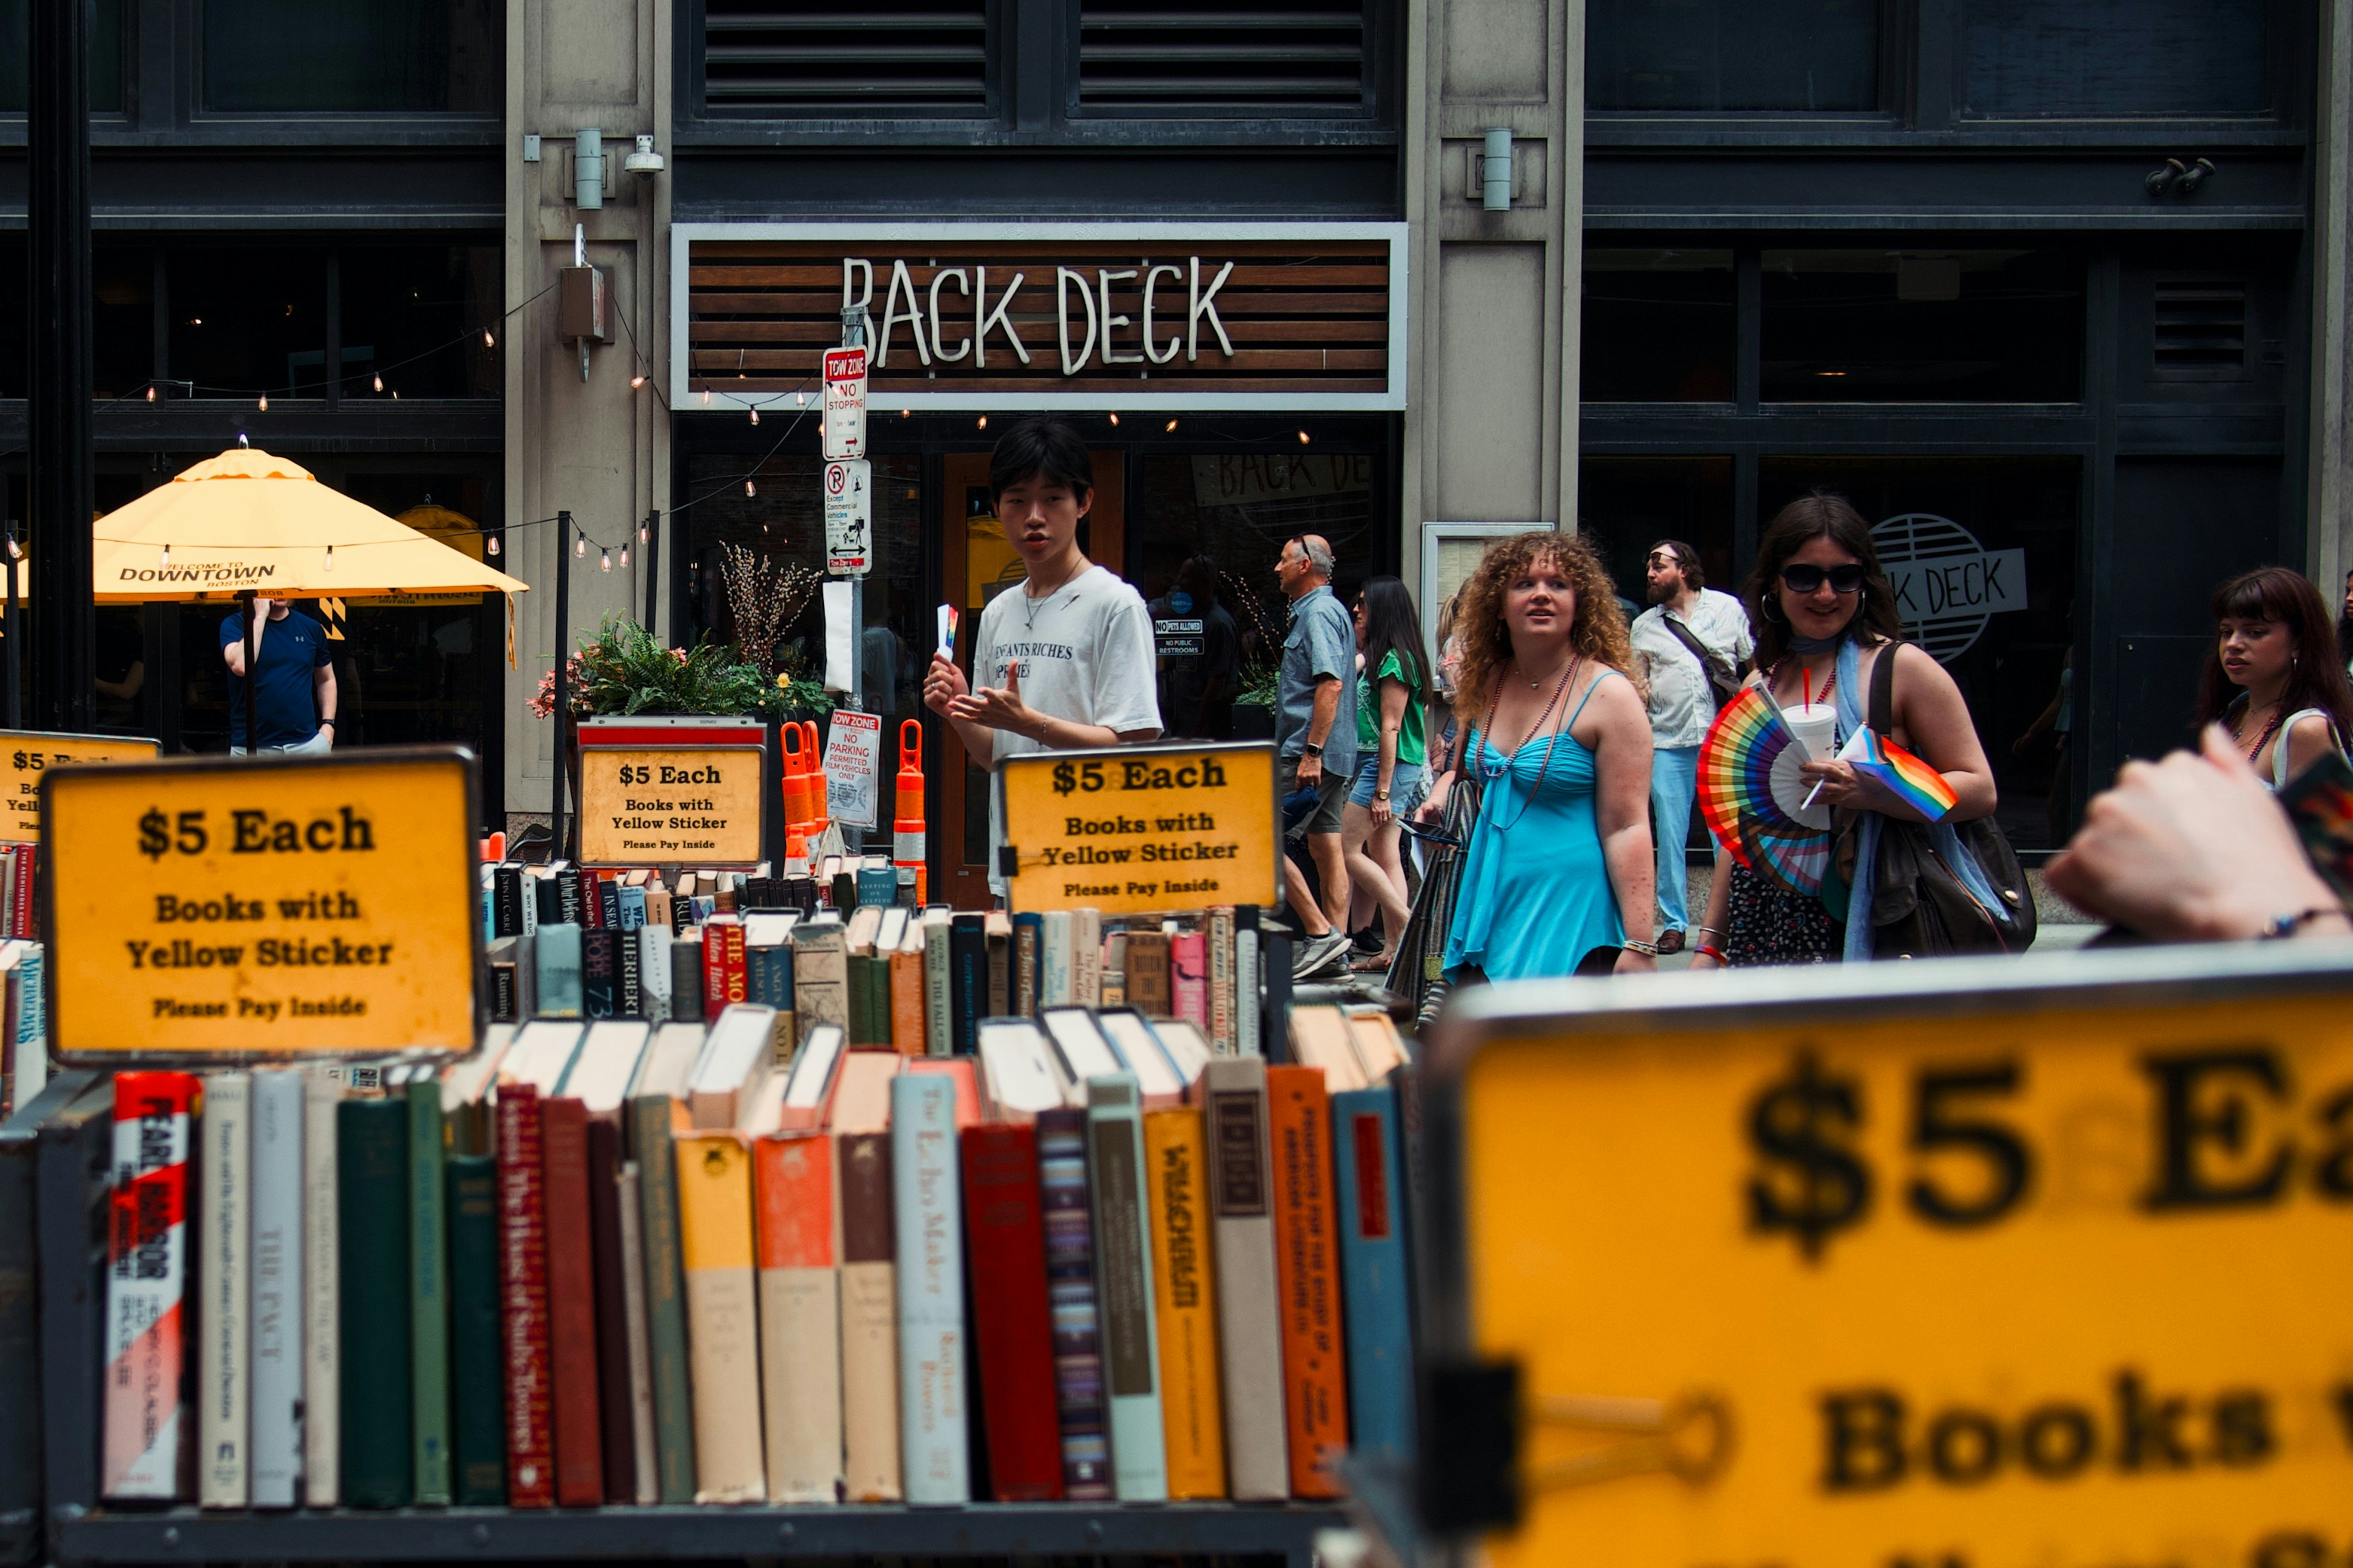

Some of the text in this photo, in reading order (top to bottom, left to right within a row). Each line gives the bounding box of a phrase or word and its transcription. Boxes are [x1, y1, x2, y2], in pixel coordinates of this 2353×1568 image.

[842, 256, 1234, 376] BACK DECK
[829, 356, 864, 377] TOW ZONE
[840, 383, 856, 397] NO
[829, 398, 863, 410] STOPPING
[1329, 454, 1369, 491] DE
[826, 495, 844, 503] Except
[826, 502, 857, 511] Commercial
[120, 564, 276, 582] DOWNTOWN
[206, 578, 259, 588] BOSTON
[1925, 557, 2006, 615] DECK
[1156, 621, 1167, 632] NO
[1031, 642, 1073, 660] RICHES
[832, 713, 876, 729] TOW ZONE
[844, 733, 857, 743] NO
[14, 750, 45, 770] $5
[829, 743, 869, 758] PARKING
[829, 755, 867, 767] PERMITTED
[619, 764, 722, 786] $5 Each
[826, 761, 871, 775] FILM VEHICLES
[839, 771, 855, 780] ONLY
[1052, 758, 1226, 797] $5 Each
[625, 799, 713, 811] Books with
[138, 804, 375, 863] $5 Each
[612, 817, 728, 829] Yellow Sticker
[1065, 813, 1215, 836] Books with
[623, 840, 715, 850] Please Pay Inside
[1042, 841, 1239, 866] Yellow Sticker
[18, 866, 26, 911] ARCHIMEDES
[500, 874, 511, 894] JOHN
[1064, 878, 1219, 898] Please Pay Inside
[154, 891, 360, 923] Books with
[585, 890, 594, 904] Owl
[605, 895, 615, 905] IN
[502, 904, 511, 932] CARRÉ
[526, 911, 532, 922] WE
[649, 934, 658, 962] PARIS
[725, 926, 743, 965] THE
[1021, 931, 1034, 947] The
[126, 938, 393, 969] Yellow Sticker
[586, 934, 604, 979] POPE
[707, 927, 725, 1002] Alden Hatch
[623, 935, 639, 1016] HERBERT
[496, 972, 510, 1021] Running
[587, 986, 614, 1019] 73
[153, 995, 365, 1023] Please Pay Inside
[1738, 1038, 2040, 1273] $5
[136, 1097, 175, 1282] PEARL HARBOR
[507, 1168, 530, 1213] The
[916, 1088, 949, 1295] The Echo Maker
[506, 1216, 529, 1279] House
[258, 1228, 283, 1362] THE PACT
[511, 1283, 532, 1309] of
[1815, 1367, 2279, 1497] Books
